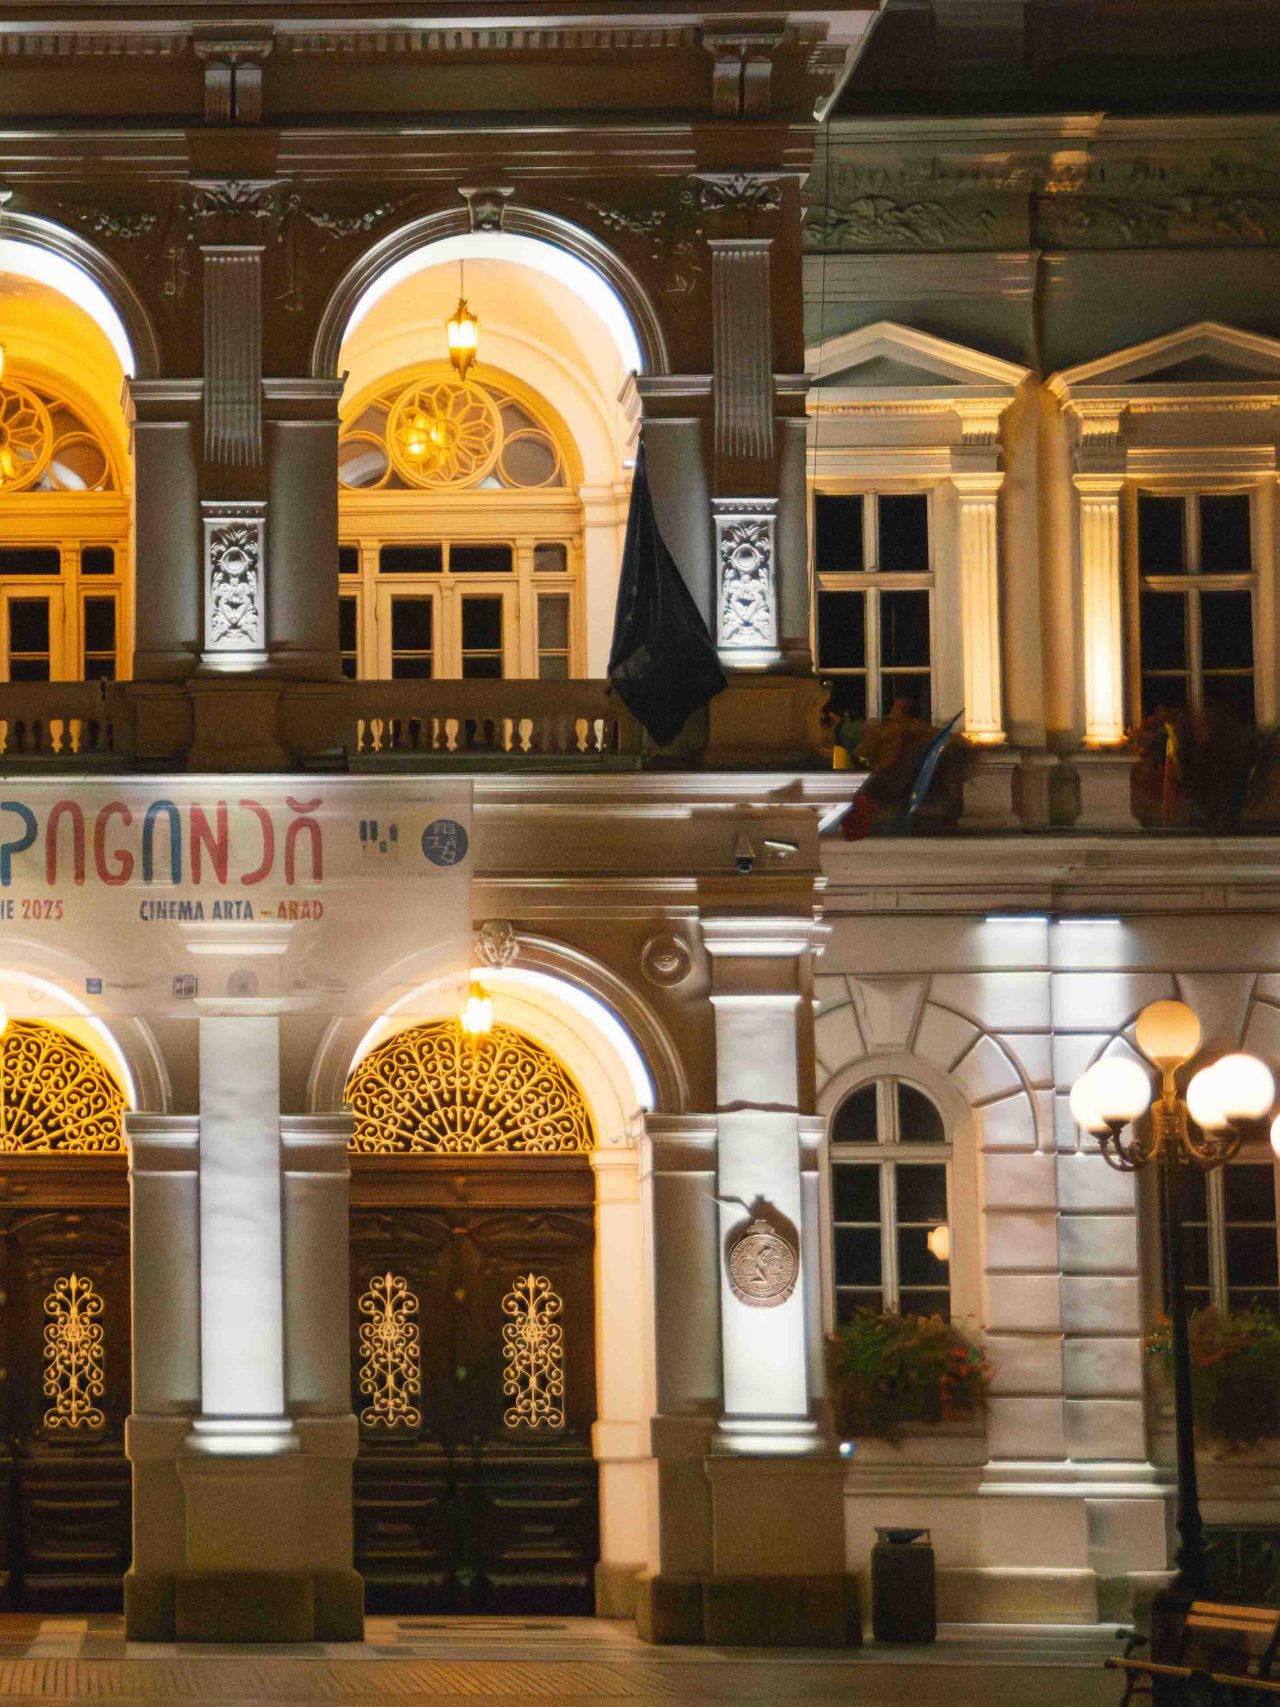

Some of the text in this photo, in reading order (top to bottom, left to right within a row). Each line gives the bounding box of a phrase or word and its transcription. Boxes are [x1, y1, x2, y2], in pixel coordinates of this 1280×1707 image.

[21, 899, 63, 920] 2025
[139, 900, 204, 921] CINEMA
[212, 900, 254, 920] ARTA
[277, 900, 324, 920] ARAD
